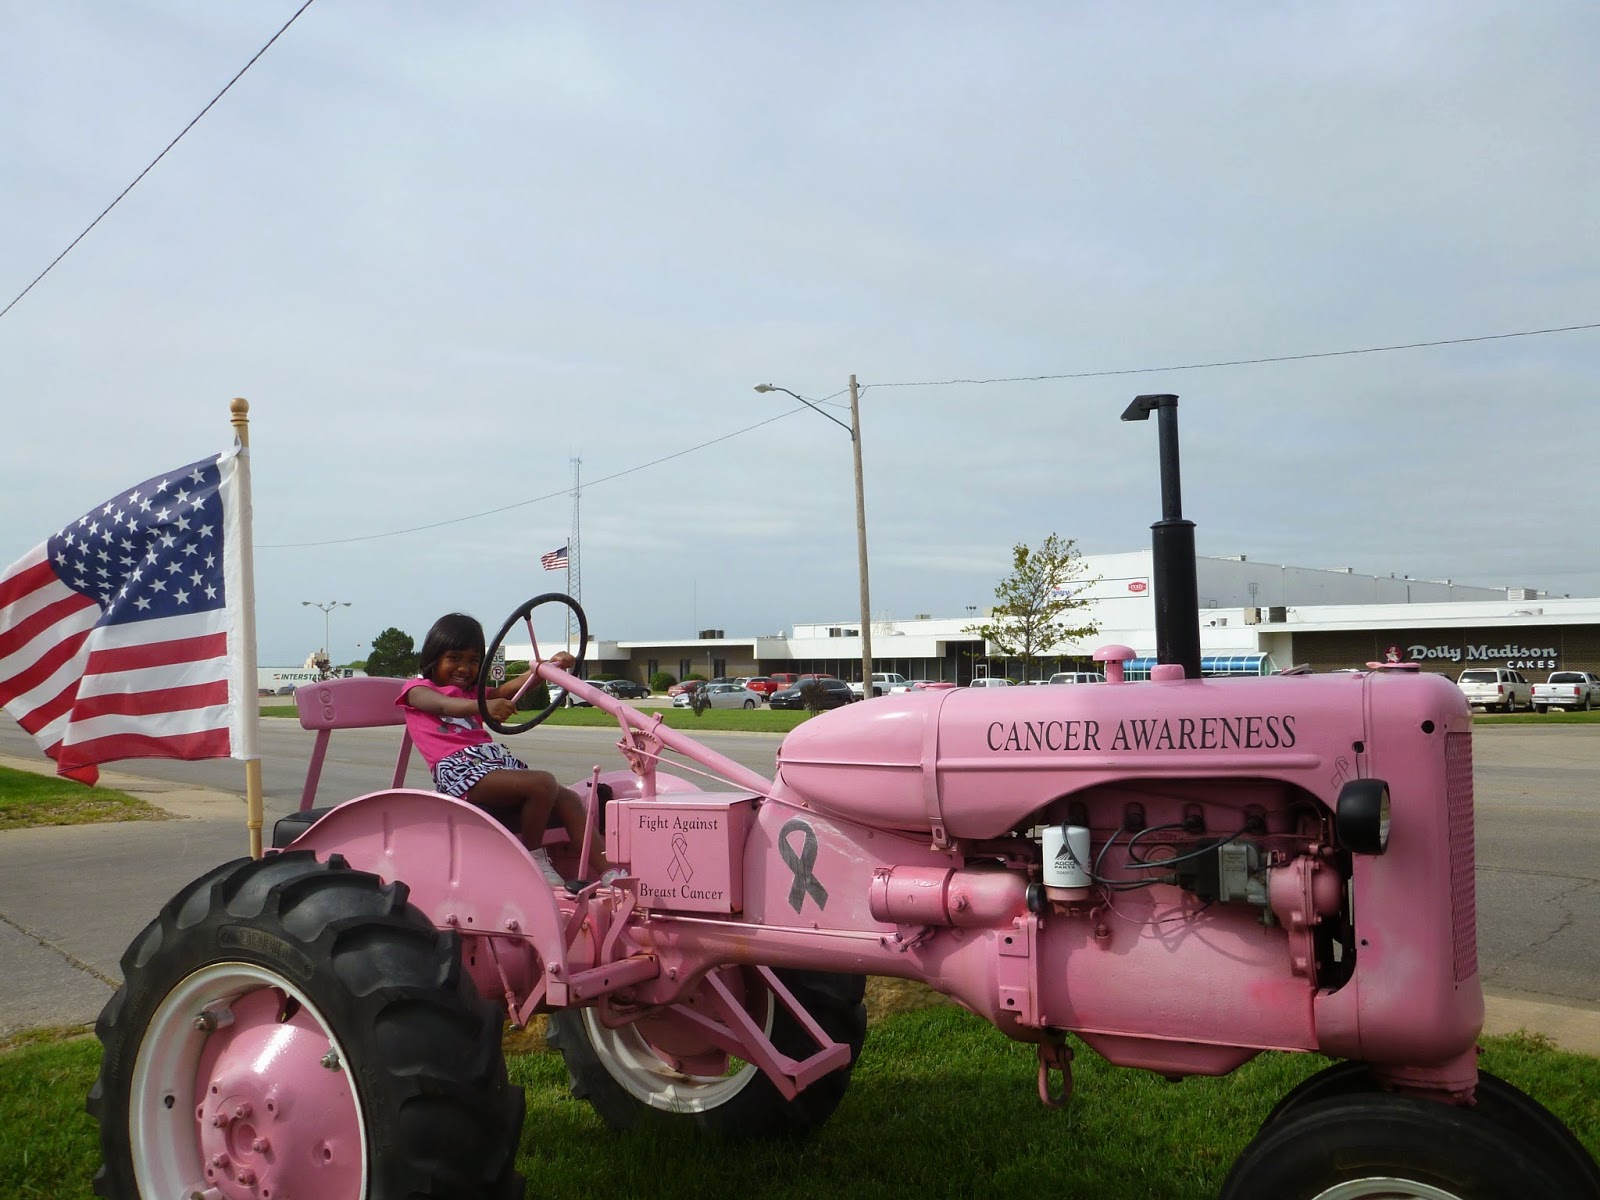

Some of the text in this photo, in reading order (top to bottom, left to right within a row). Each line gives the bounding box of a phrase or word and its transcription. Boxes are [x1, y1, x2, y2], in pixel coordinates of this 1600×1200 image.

[1406, 644, 1558, 661] Dolly Madison
[1506, 660, 1556, 669] CAKES
[986, 715, 1296, 751] CANCER AWARENESS
[639, 815, 718, 832] Fight Against
[640, 883, 723, 900] Breast Cancer
